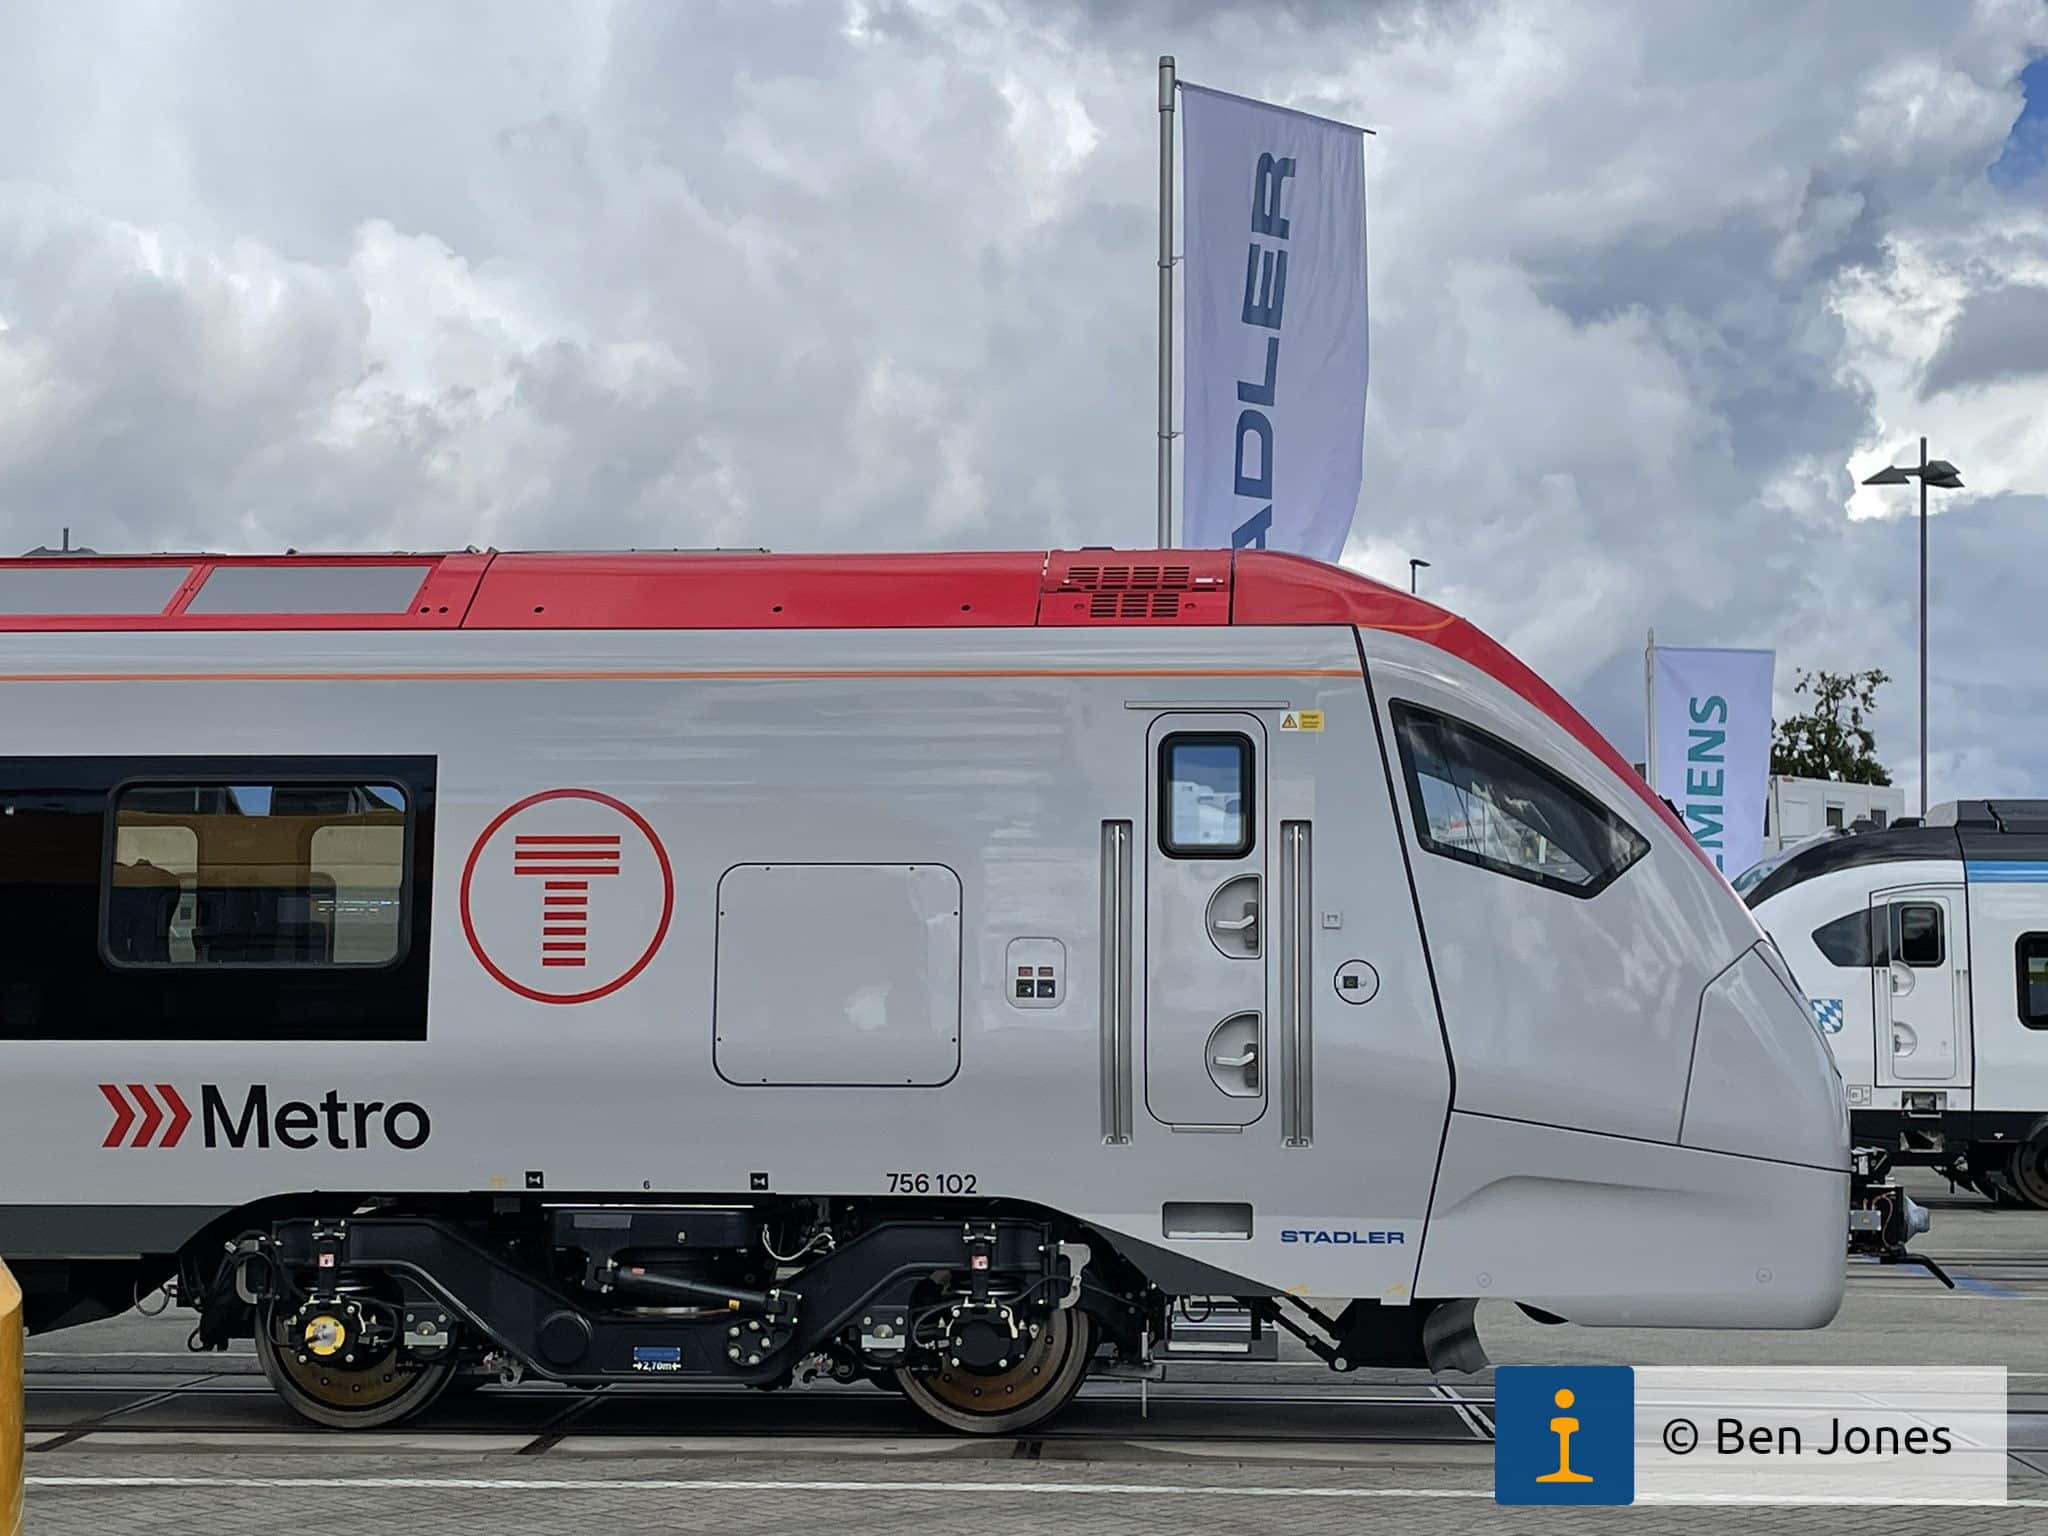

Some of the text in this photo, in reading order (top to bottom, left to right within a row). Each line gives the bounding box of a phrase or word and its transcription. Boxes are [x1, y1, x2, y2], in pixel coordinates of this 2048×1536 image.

[1685, 695, 1728, 874] MENS
[201, 1084, 431, 1150] Metro
[886, 1173, 977, 1194] 756 102
[1280, 1230, 1405, 1244] STADLER
